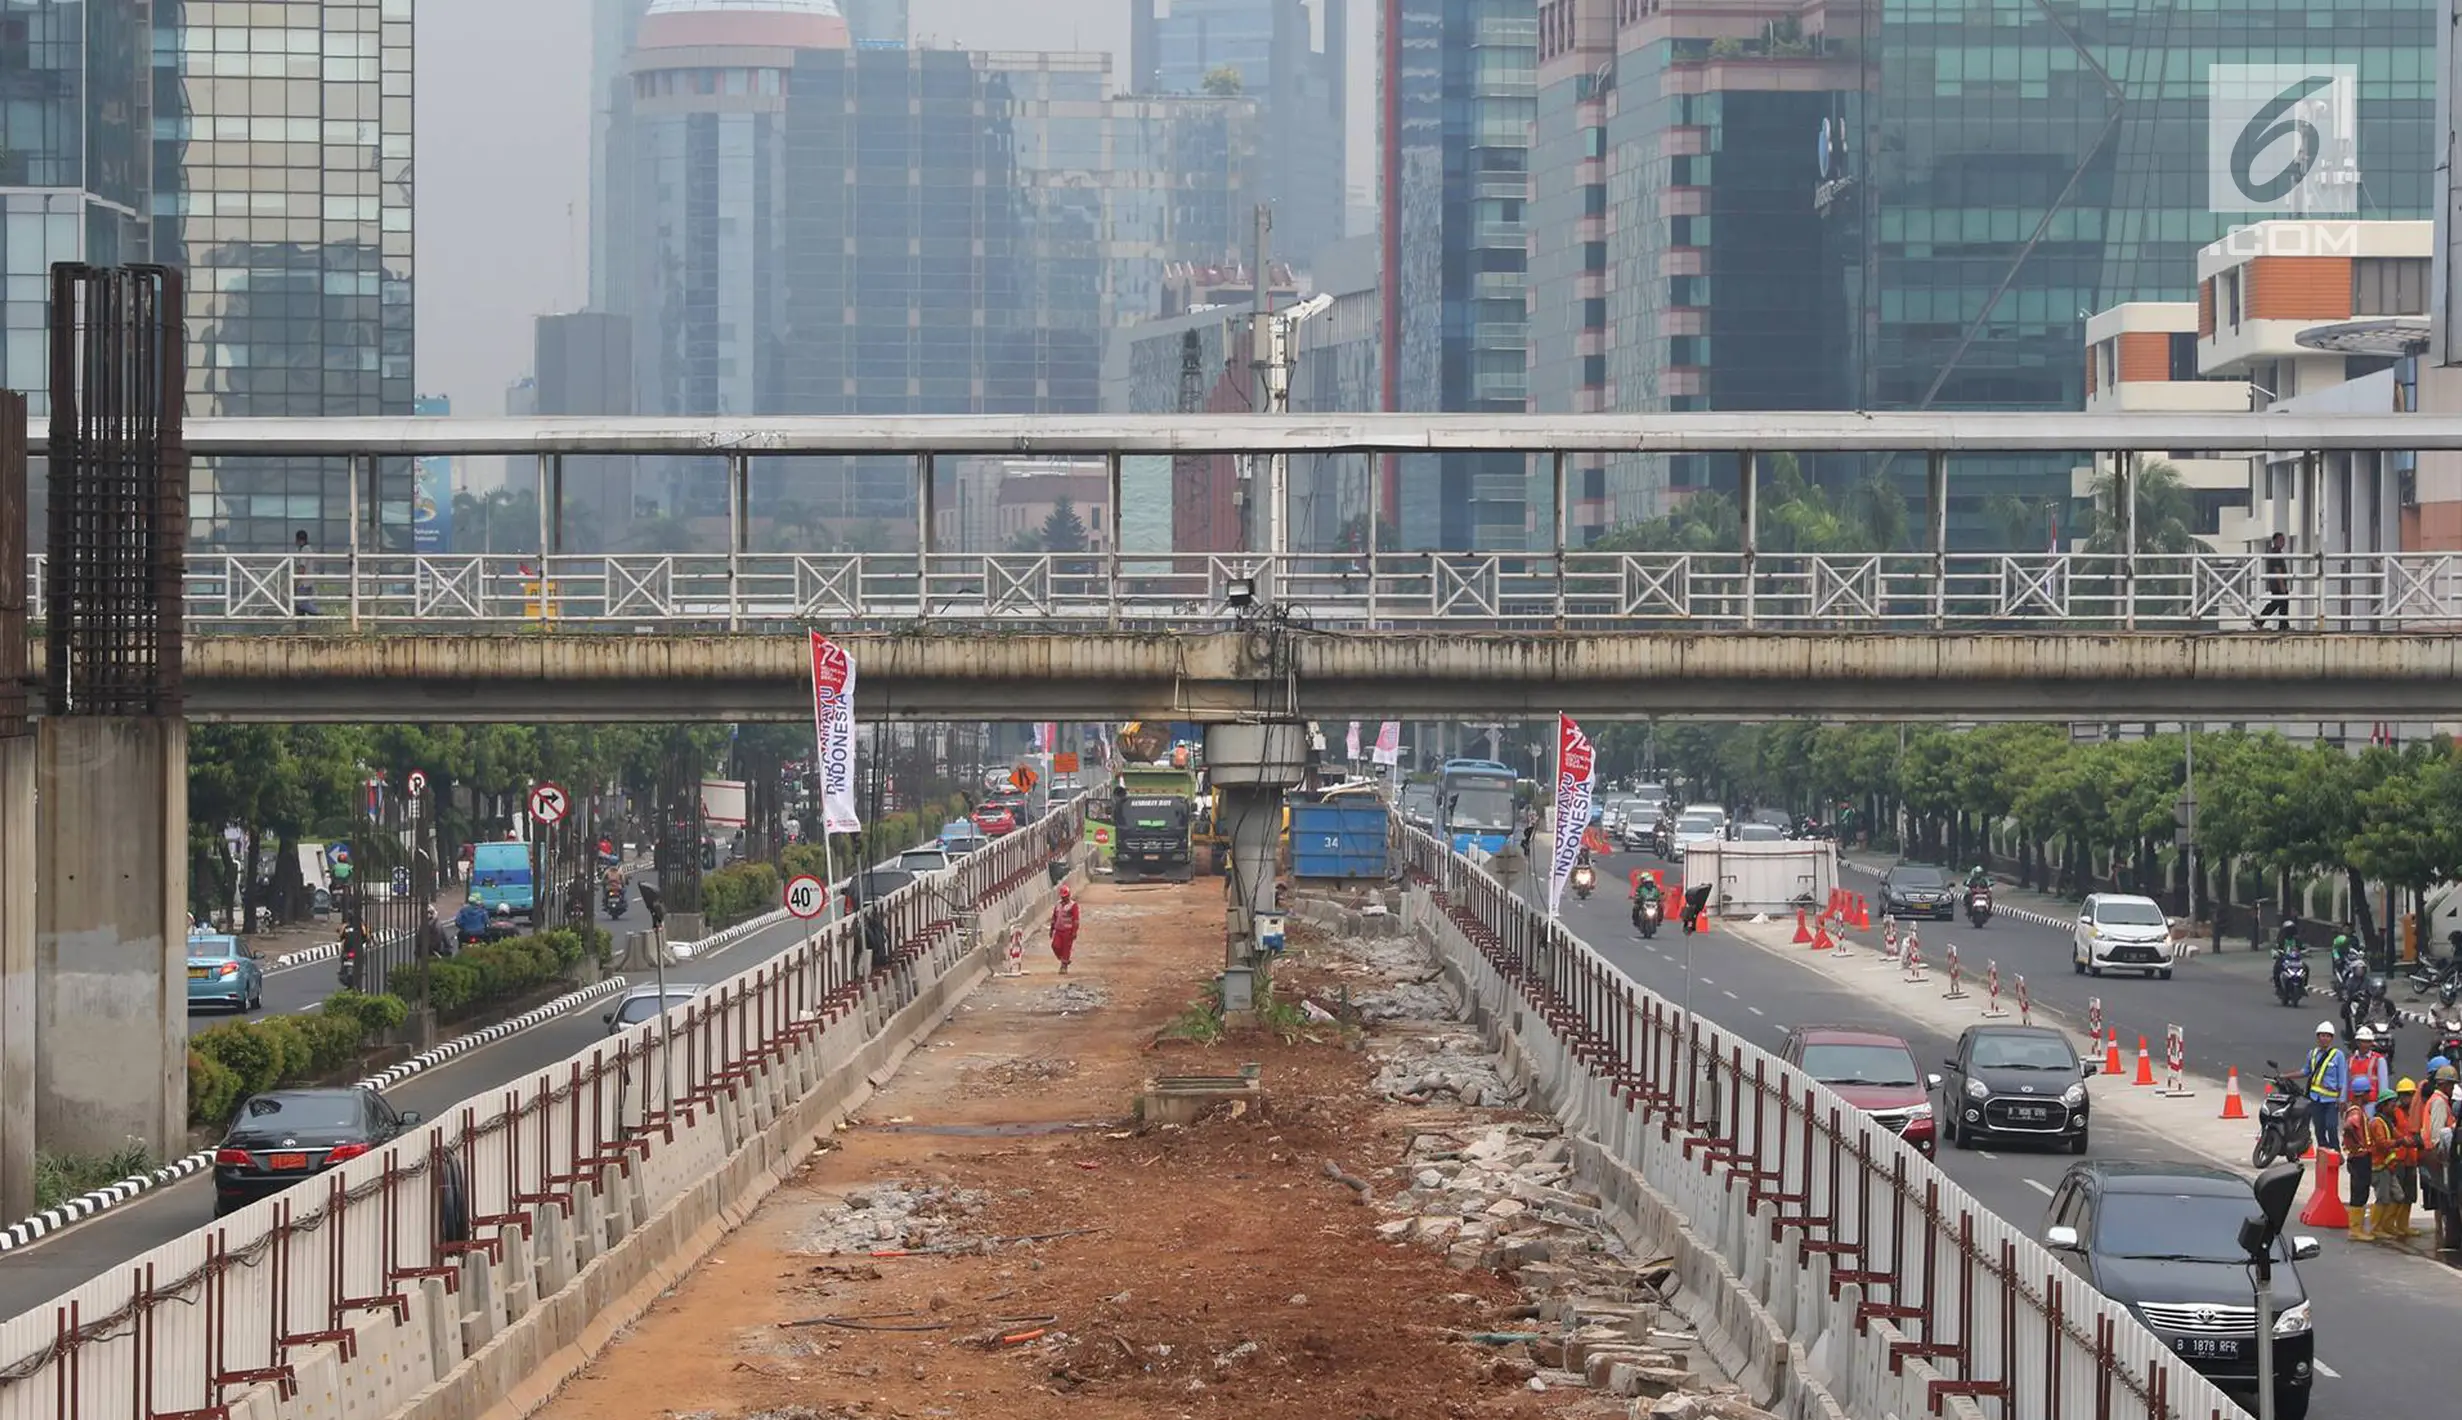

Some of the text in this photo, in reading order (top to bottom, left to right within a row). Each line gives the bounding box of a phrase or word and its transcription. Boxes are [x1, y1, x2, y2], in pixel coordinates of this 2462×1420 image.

[832, 693, 848, 792] INDONESIA
[1555, 781, 1591, 877] INDONESIA
[1324, 836, 1339, 848] 34
[791, 887, 810, 907] 40
[2177, 1339, 2238, 1353] B 1878 RFR
